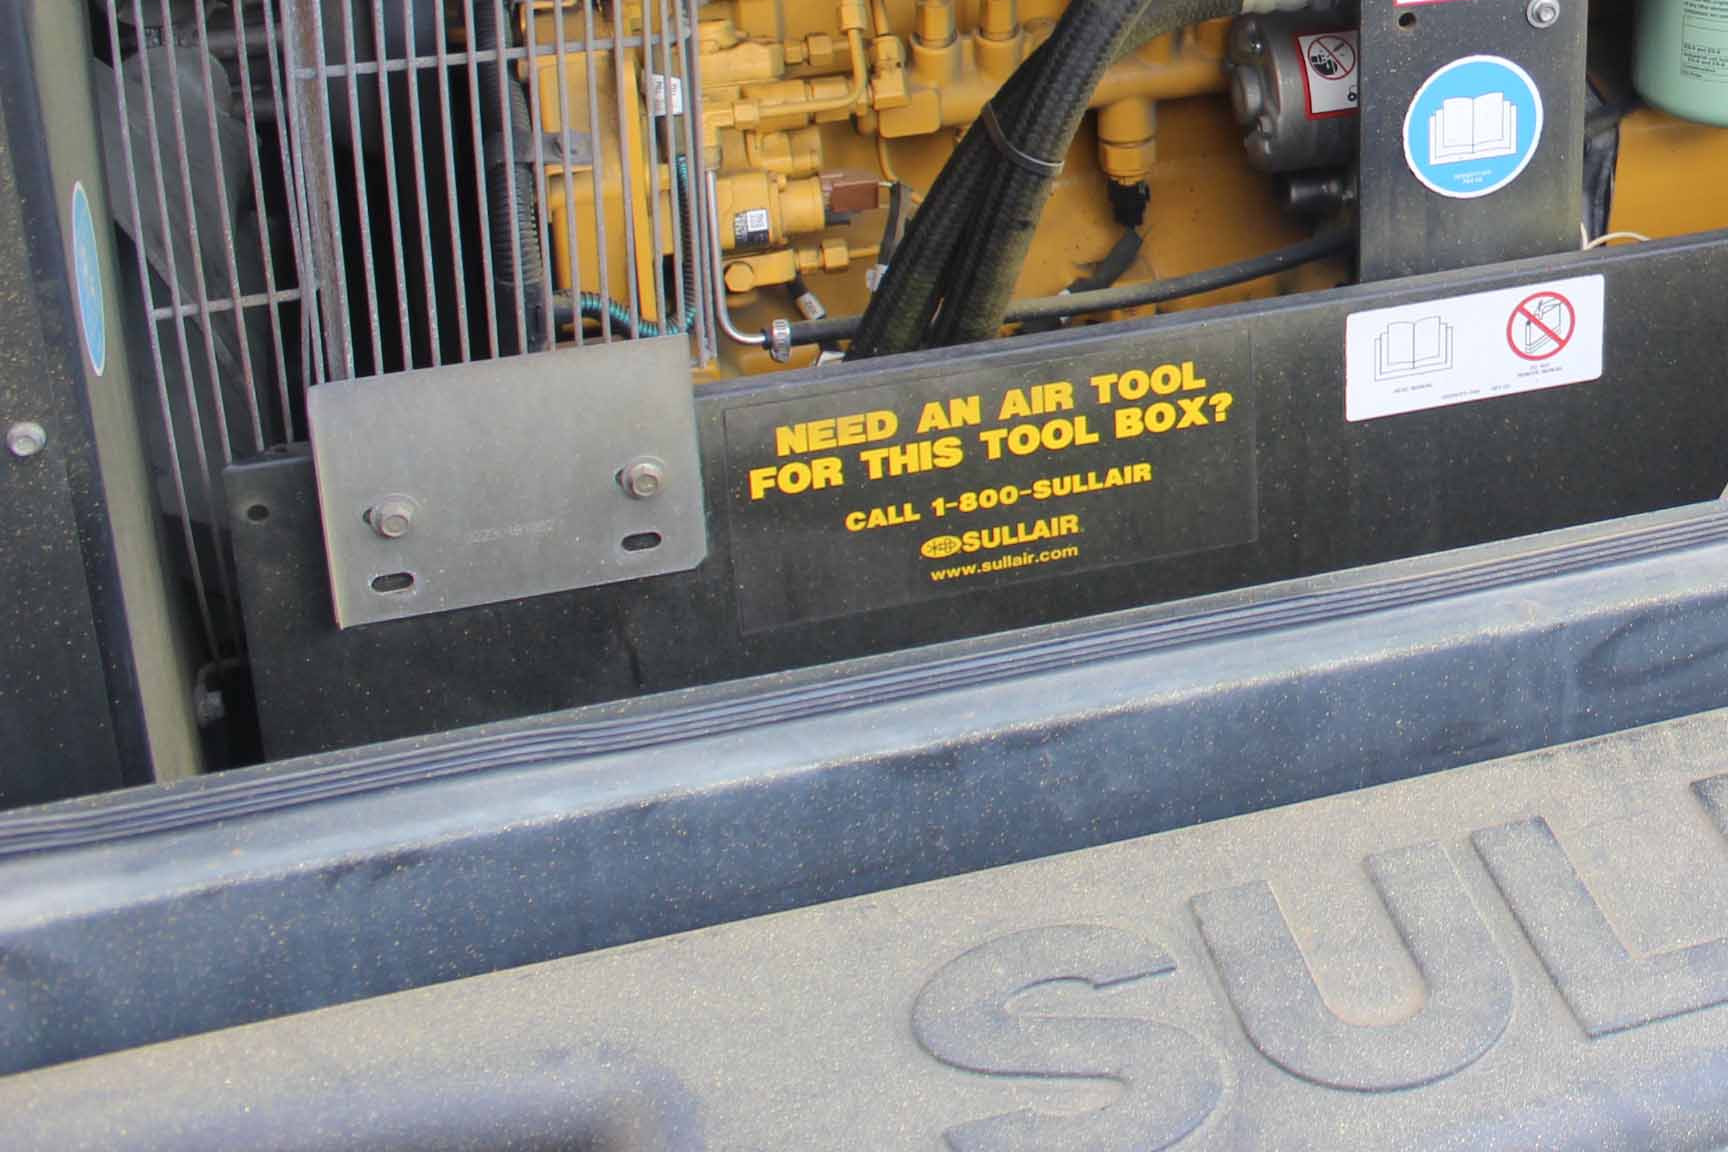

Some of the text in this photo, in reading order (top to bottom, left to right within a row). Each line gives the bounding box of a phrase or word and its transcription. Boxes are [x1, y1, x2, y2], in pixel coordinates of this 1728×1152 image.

[776, 360, 1207, 457] NEED AN AIR TOOL
[749, 392, 1233, 500] FOR THIS TOOL BOX?
[845, 462, 1153, 532] CALL 1-800-SULLAIR
[930, 544, 1079, 581] www.sullair.com
[961, 513, 1080, 553] SULLAIR
